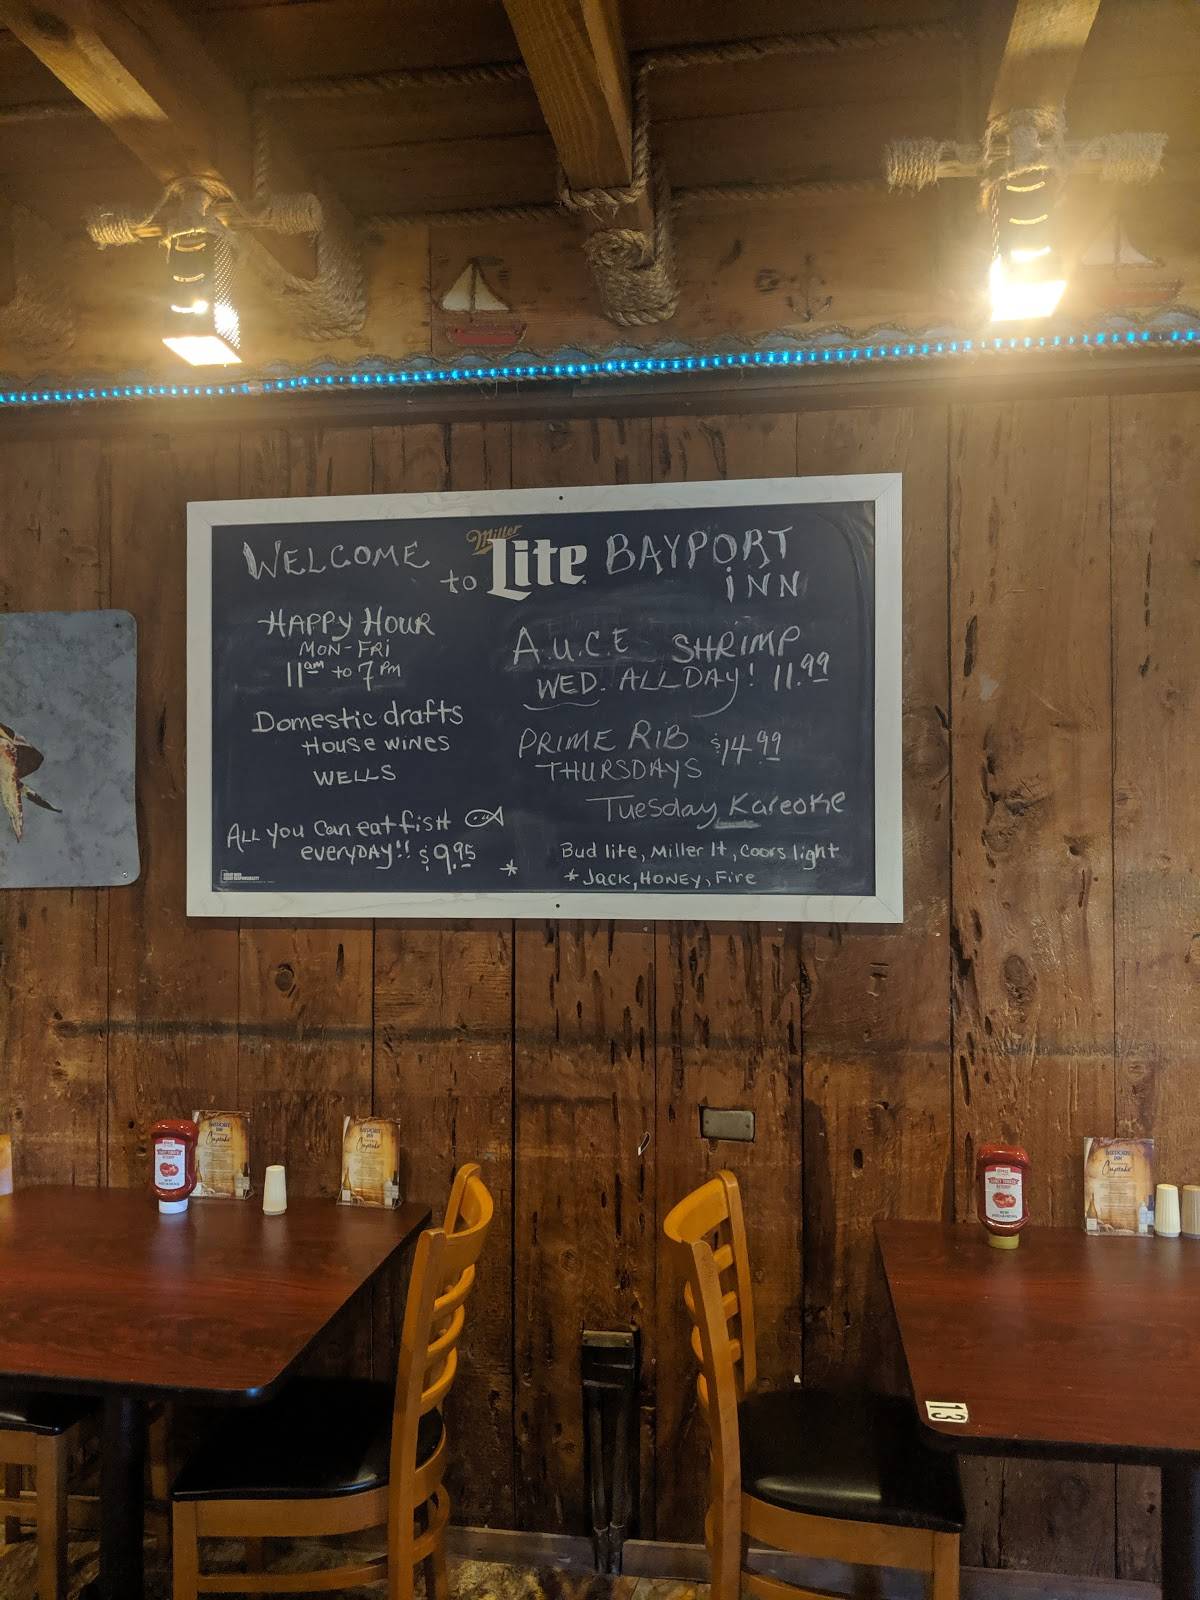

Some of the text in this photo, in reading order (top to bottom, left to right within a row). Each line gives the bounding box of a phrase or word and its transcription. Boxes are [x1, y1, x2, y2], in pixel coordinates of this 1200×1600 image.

[466, 524, 524, 556] Miller
[606, 526, 793, 575] BAYPORT
[243, 540, 430, 579] WELCOME
[487, 538, 588, 601] Lite
[440, 569, 477, 594] to
[257, 605, 436, 641] HAPPY HOUR
[672, 625, 800, 663] SHRIMP
[332, 666, 352, 679] to
[251, 699, 463, 732] Domestic drafts
[518, 727, 617, 759] PRIME
[627, 719, 689, 751] RIB
[313, 764, 396, 786] WELLS
[535, 757, 703, 788] THURSDAYS
[356, 815, 396, 837] eat
[585, 794, 718, 829] Tuesday
[560, 842, 597, 858] Bud
[740, 844, 786, 860] Coors
[793, 844, 840, 870] light
[715, 870, 757, 885] Fire
[929, 1405, 966, 1420] 13
